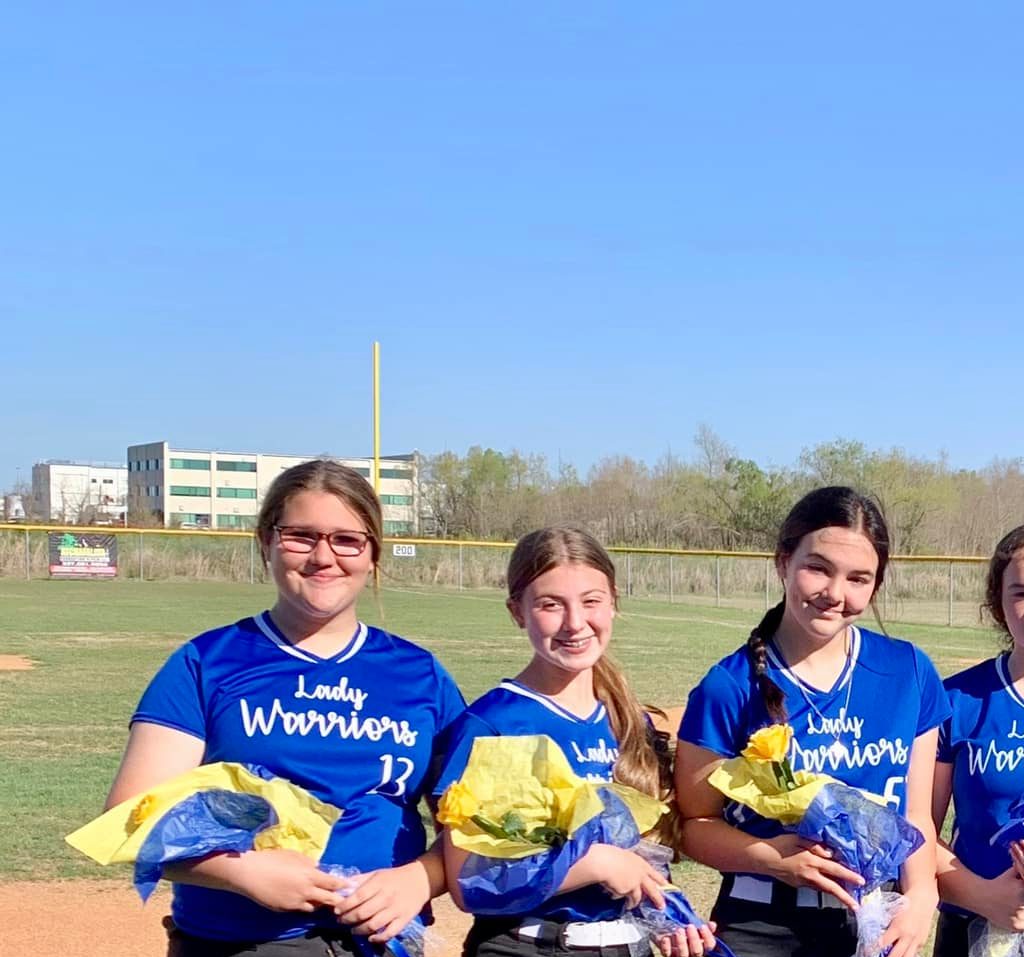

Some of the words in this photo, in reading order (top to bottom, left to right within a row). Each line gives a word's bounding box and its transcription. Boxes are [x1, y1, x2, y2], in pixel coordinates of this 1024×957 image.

[395, 545, 413, 555] 200
[294, 674, 368, 711] Lady
[239, 698, 419, 747] Warriors
[806, 707, 864, 738] Lady
